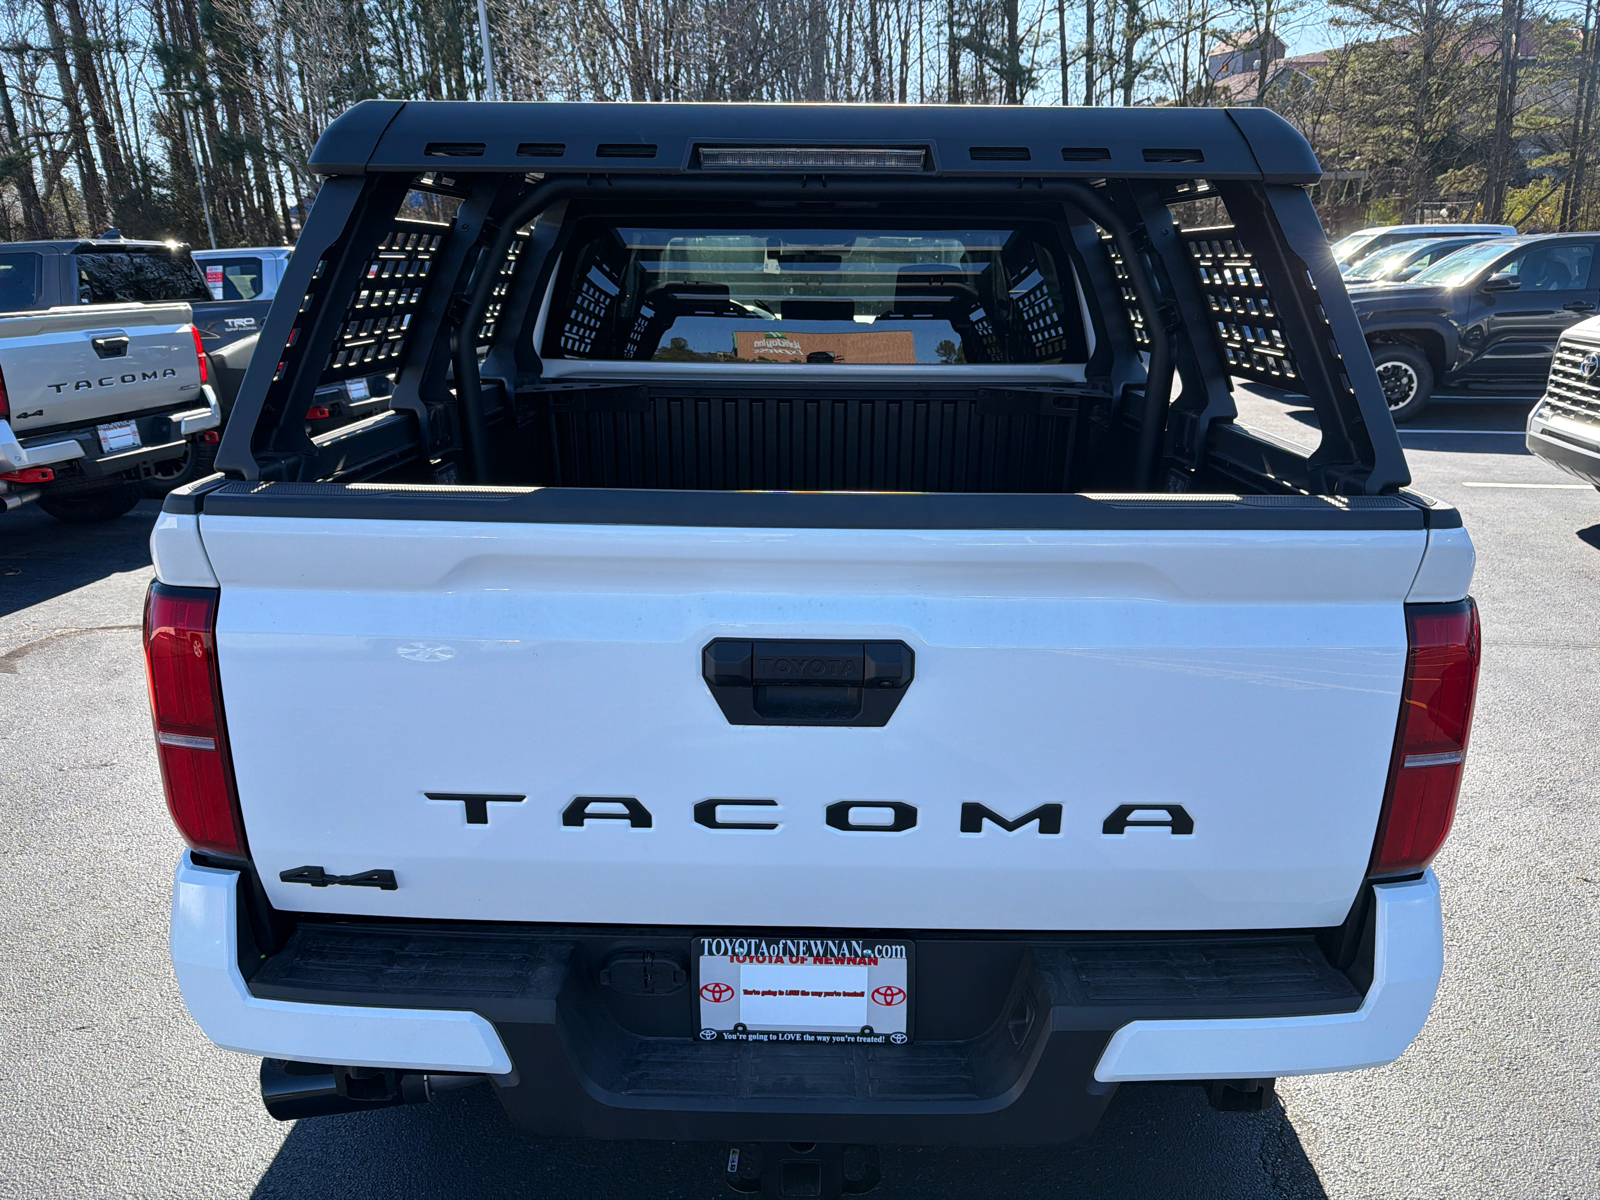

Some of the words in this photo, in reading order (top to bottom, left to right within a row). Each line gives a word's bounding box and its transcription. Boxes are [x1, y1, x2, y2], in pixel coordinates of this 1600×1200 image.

[224, 317, 255, 327] TRD
[47, 368, 177, 393] TACOMA
[758, 658, 858, 676] TOYOTA
[424, 792, 1194, 835] TACOMA
[729, 955, 785, 964] TOYOTA
[789, 956, 808, 965] OF
[812, 957, 879, 966] NEWNAN
[722, 1032, 747, 1040] You're
[748, 1033, 768, 1042] going
[778, 1033, 802, 1041] LOVE
[816, 1035, 831, 1043] way
[832, 1035, 855, 1043] you're
[856, 1035, 885, 1043] treated!
